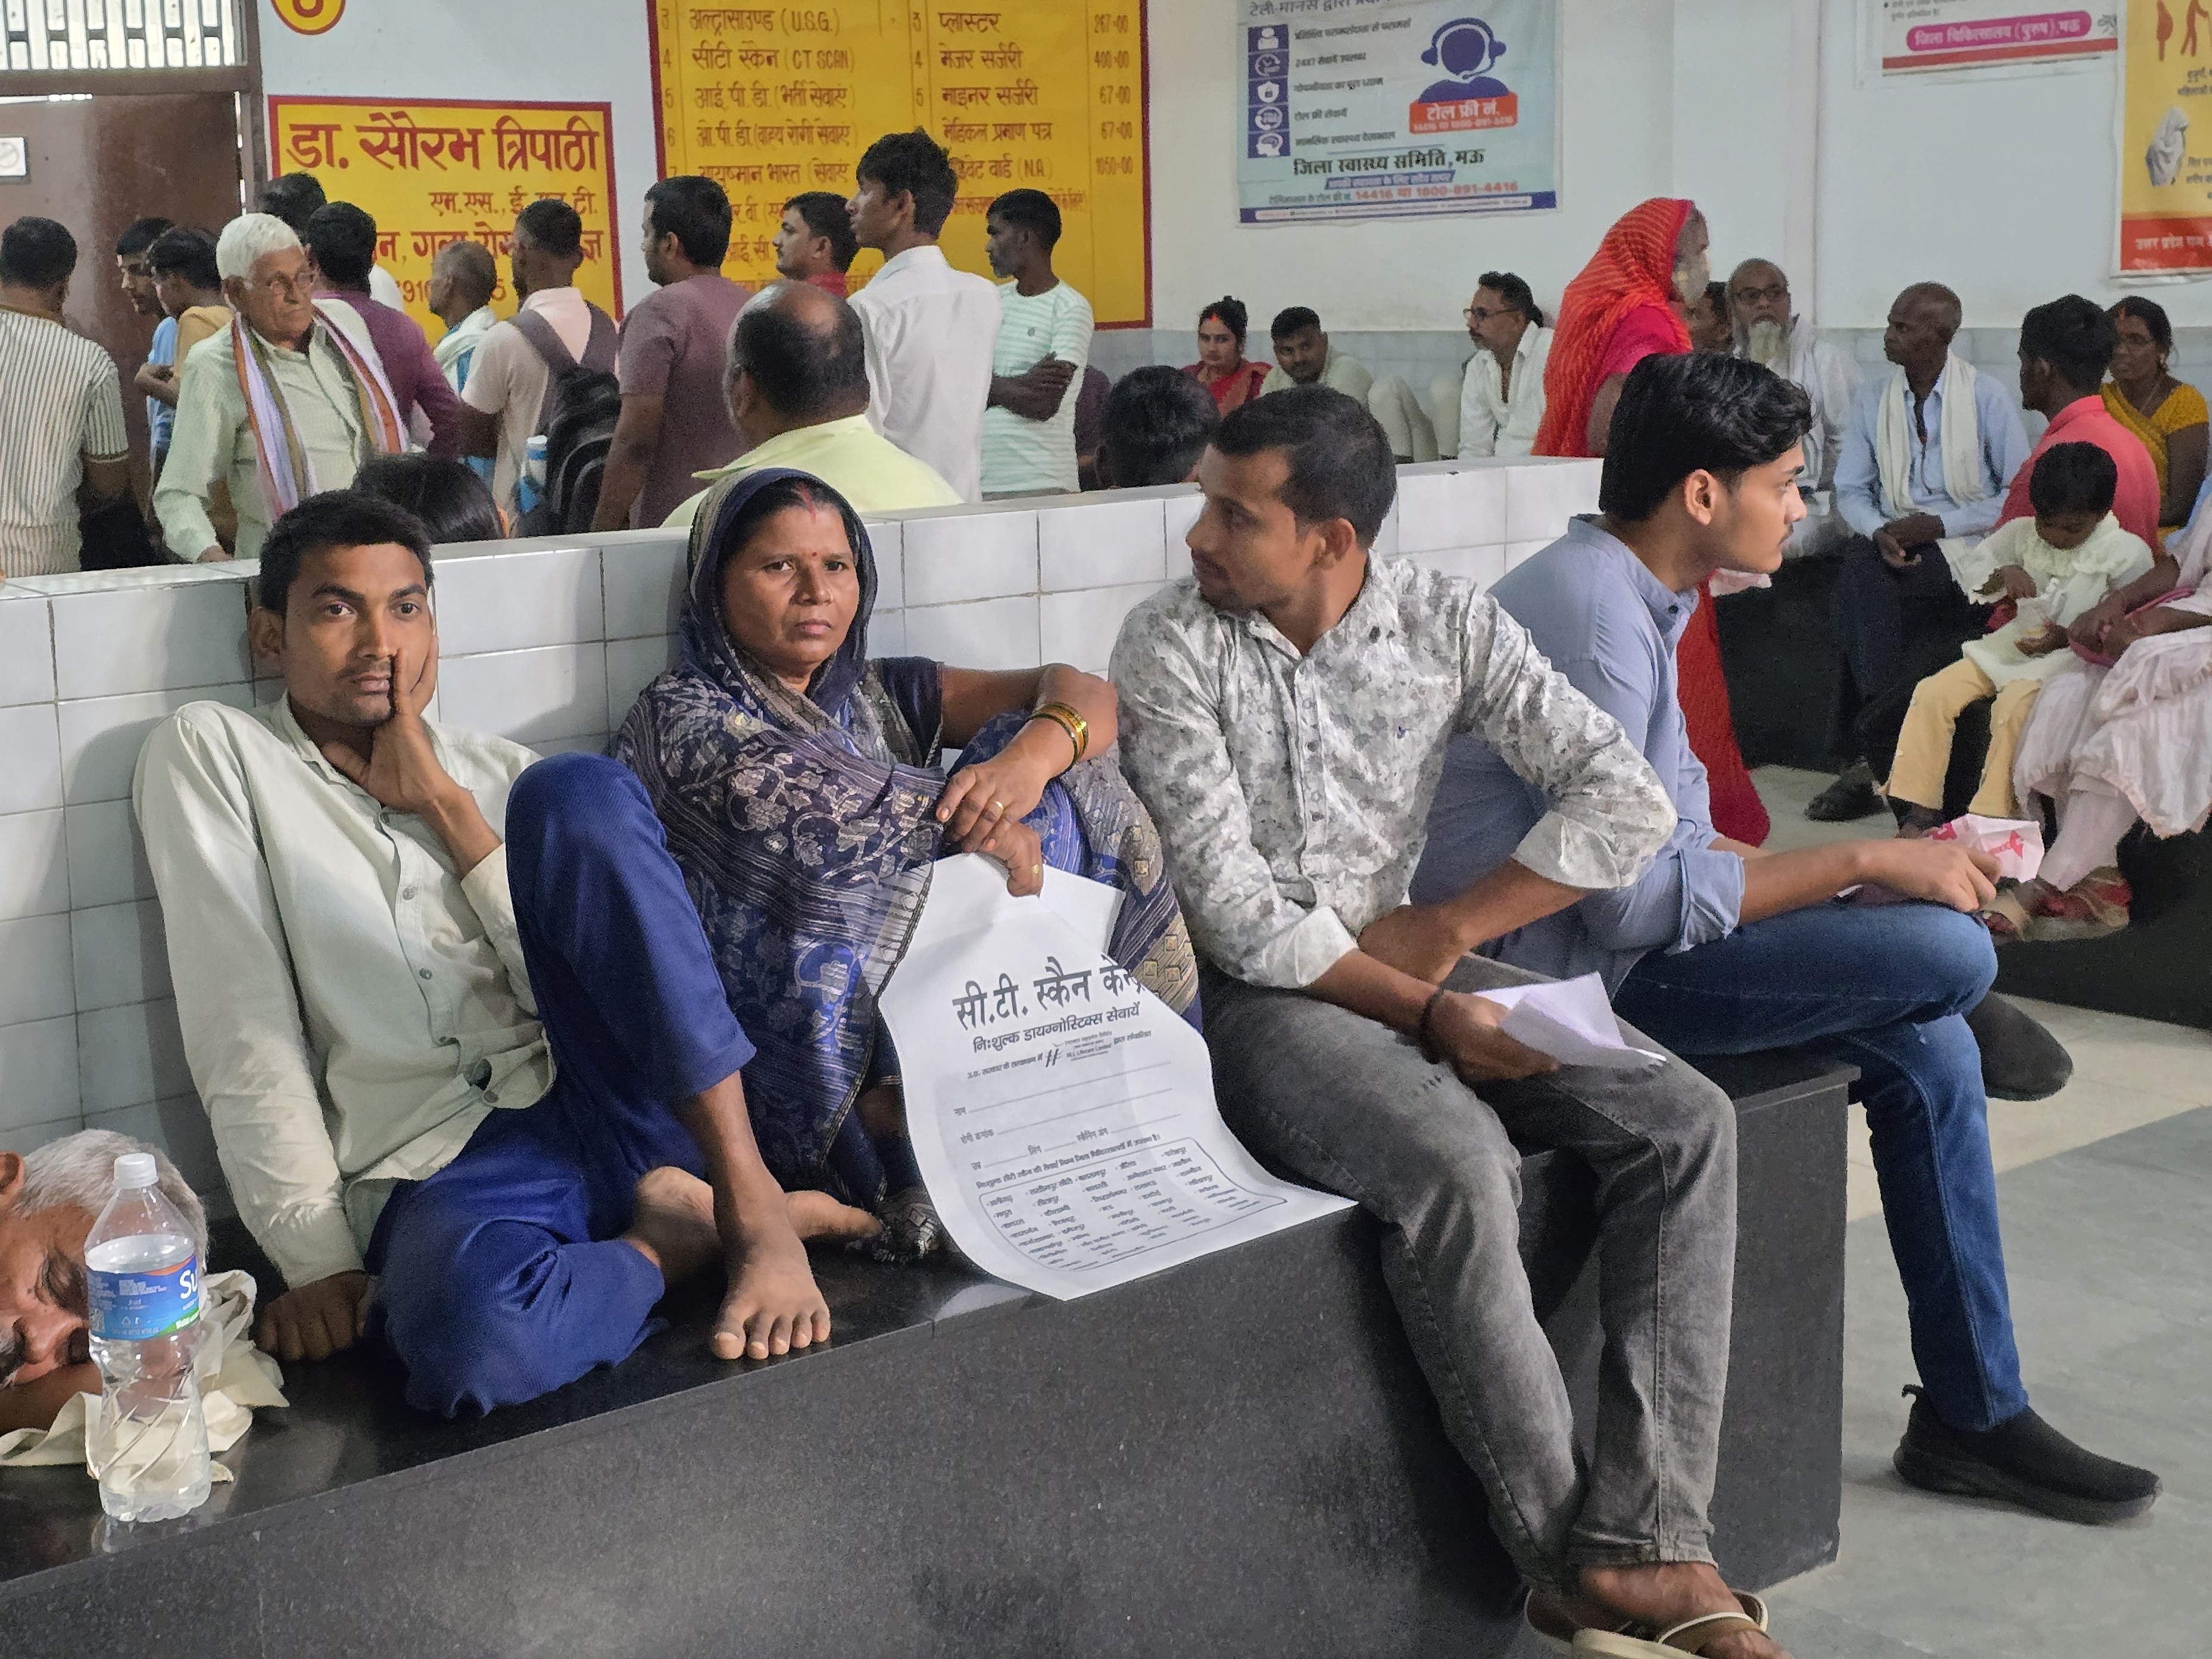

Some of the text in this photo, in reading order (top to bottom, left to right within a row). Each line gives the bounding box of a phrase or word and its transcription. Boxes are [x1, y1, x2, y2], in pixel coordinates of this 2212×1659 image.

[912, 11, 922, 33] 3
[938, 12, 1002, 34] प्लास्टर
[663, 48, 672, 70] 4
[691, 39, 733, 70] सीटी
[915, 50, 924, 70] 4
[938, 42, 975, 70] मेजर
[980, 41, 1023, 70] सर्जरी
[664, 87, 675, 109] 5
[915, 86, 924, 107] 5
[995, 77, 1039, 106] सर्जरी
[286, 111, 600, 171] डा. सौरभ त्रिपाठी
[667, 126, 676, 148] 6
[1029, 121, 1053, 142] पत्र
[766, 163, 801, 185] भारत
[1293, 158, 1333, 175] जिला
[951, 972, 1029, 1031] सी.टी.
[1033, 955, 1092, 1011] स्कैन
[1023, 1012, 1103, 1042] डायग्नोस्टिक्स
[1106, 1000, 1141, 1023] सेवायें
